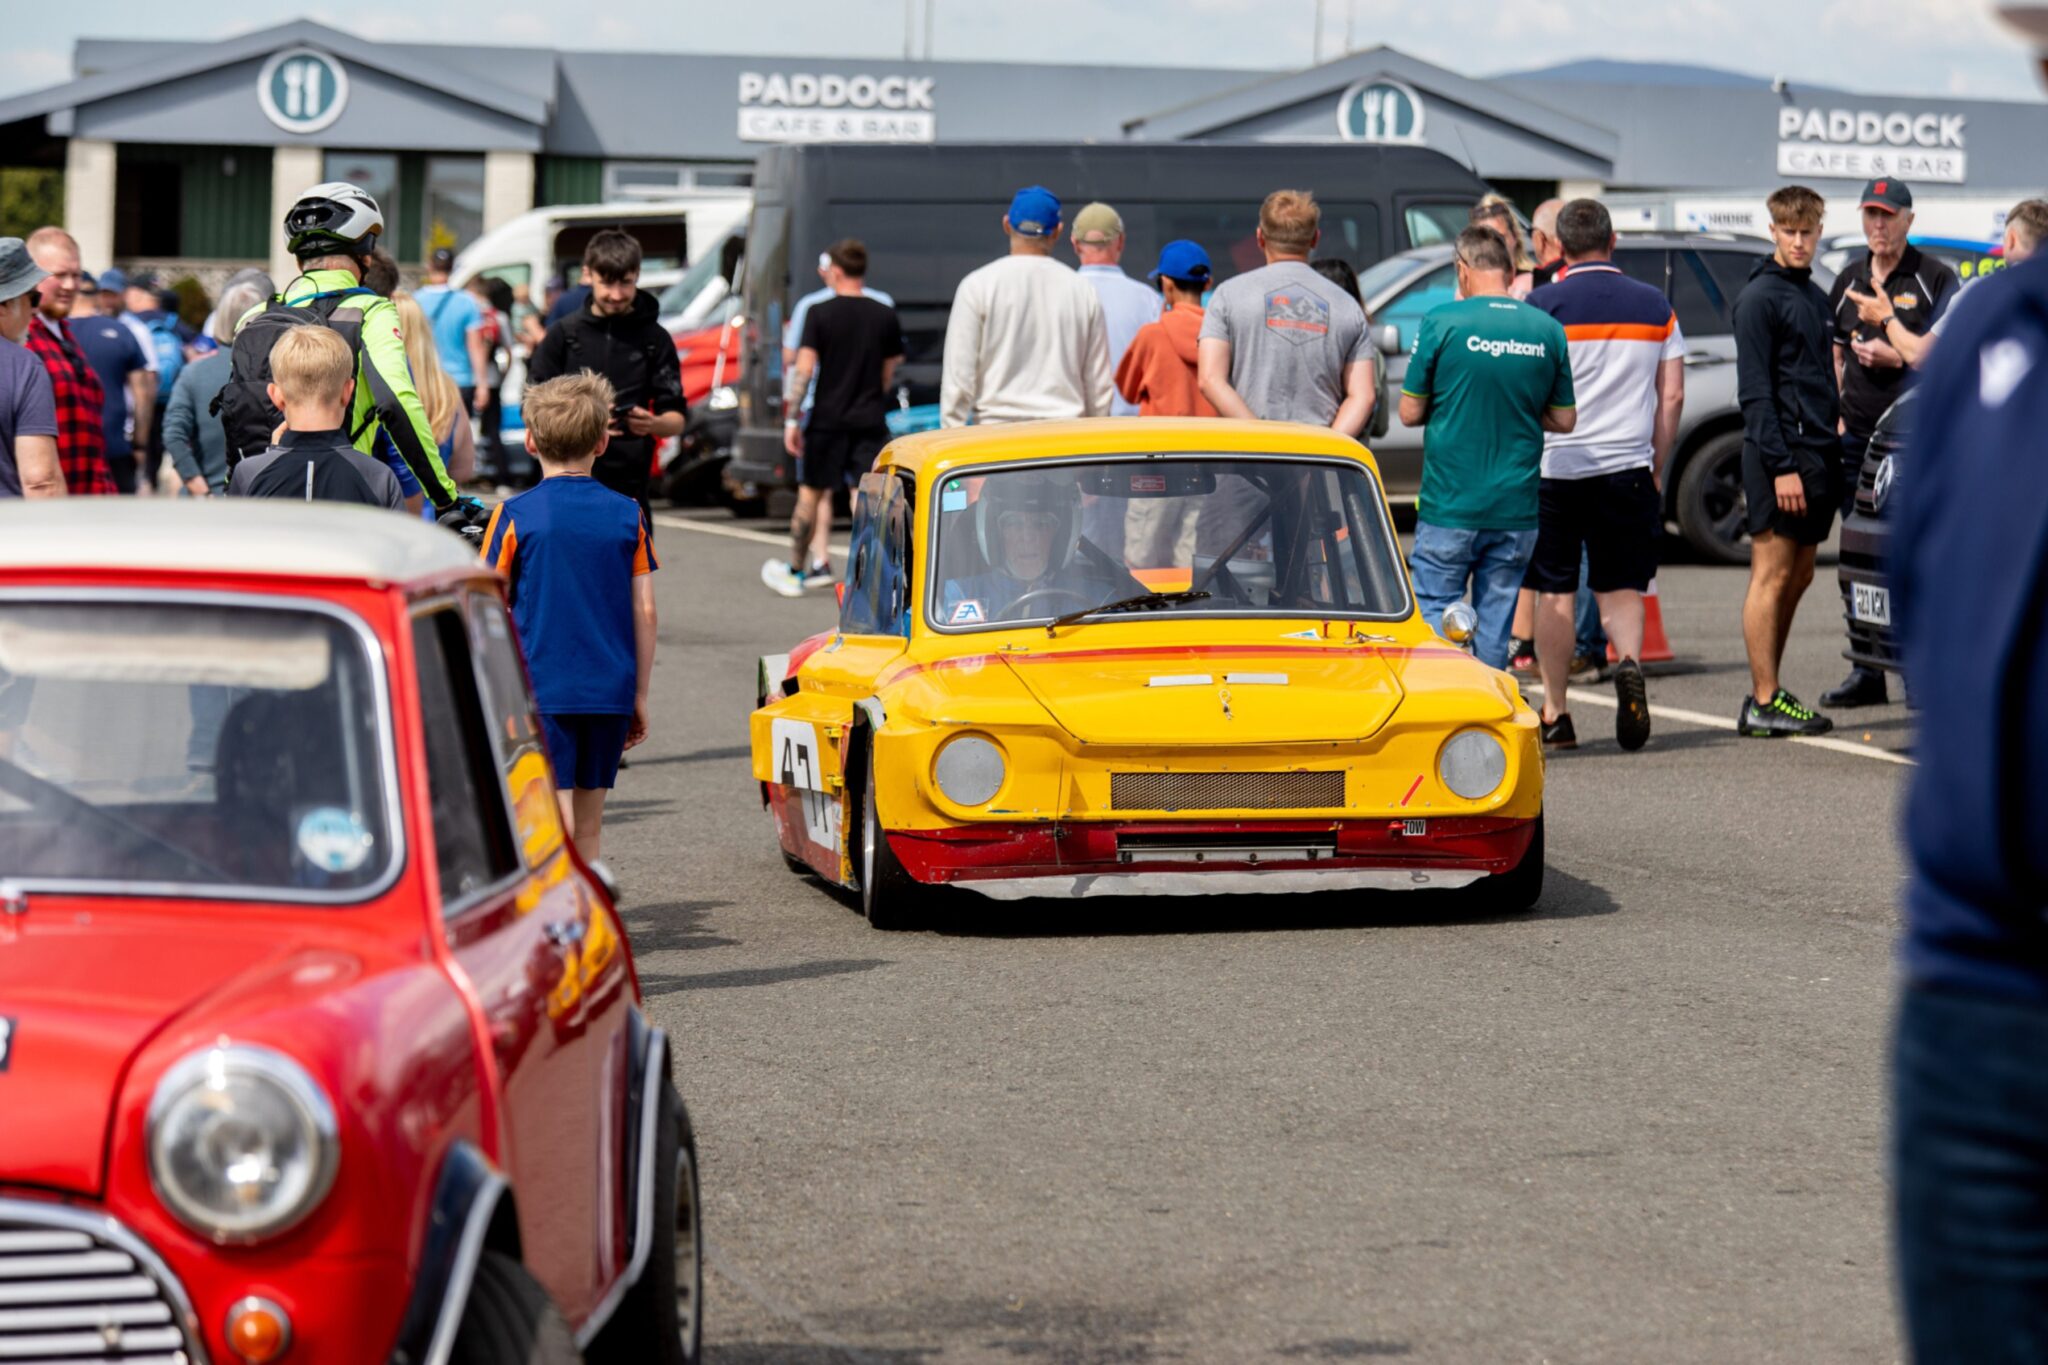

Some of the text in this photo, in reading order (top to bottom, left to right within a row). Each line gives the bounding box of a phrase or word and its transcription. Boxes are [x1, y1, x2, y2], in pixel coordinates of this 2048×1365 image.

[738, 72, 934, 108] PADDOCK
[749, 117, 923, 136] CAFE & BAR
[1779, 107, 1967, 148] PADDOCK
[1788, 152, 1953, 176] CAFE & BAR
[1466, 335, 1546, 357] Cognizant
[1404, 820, 1425, 835] TOW
